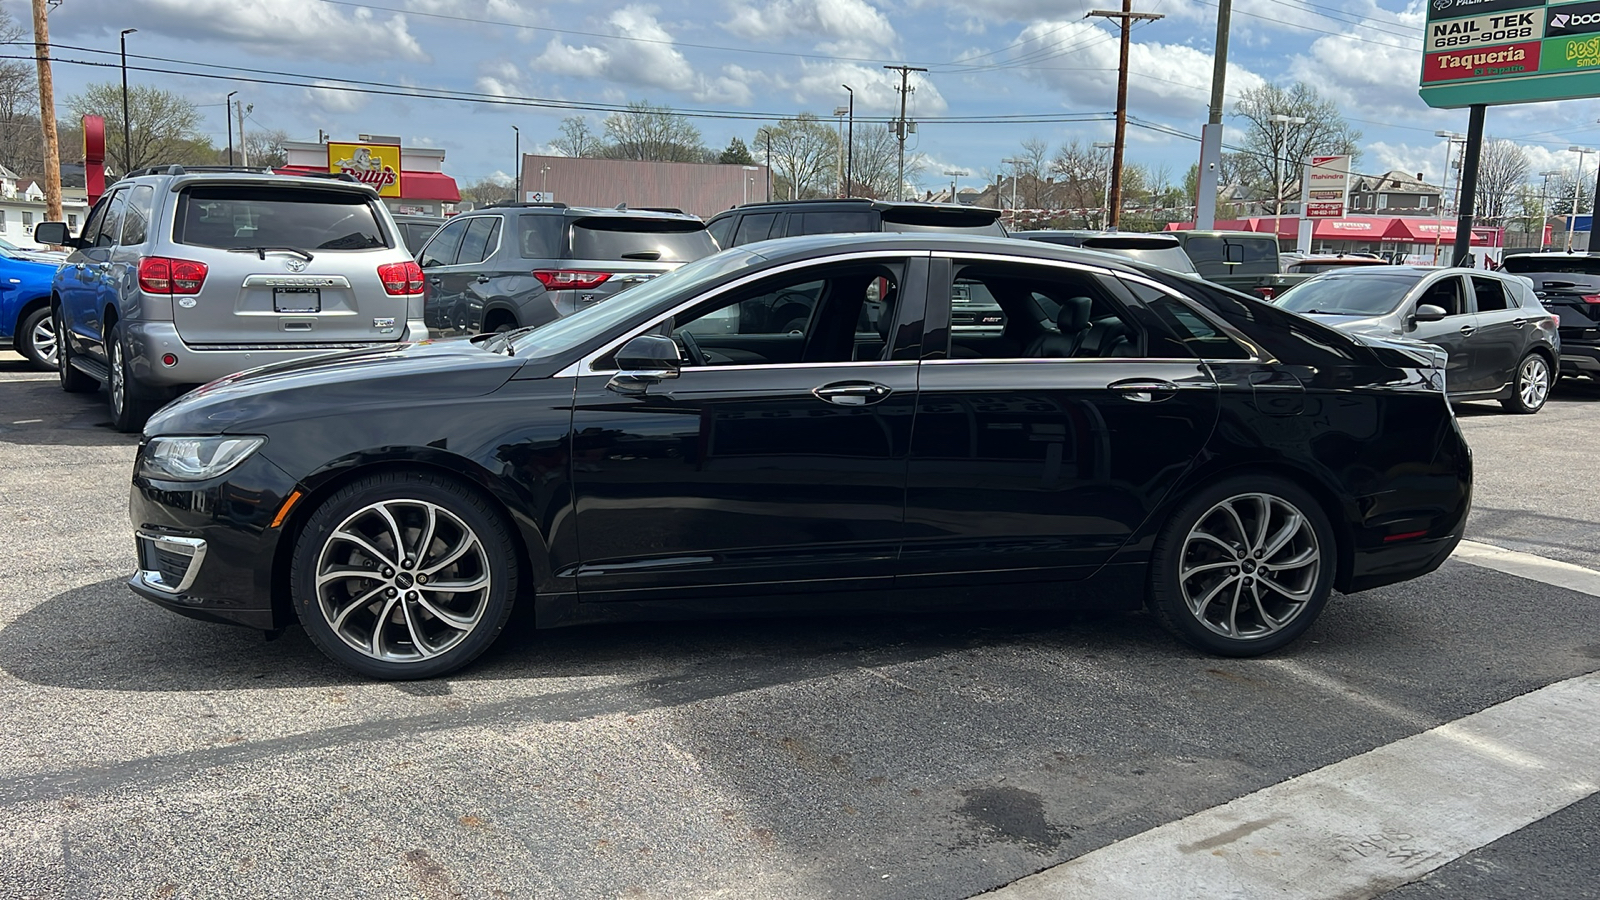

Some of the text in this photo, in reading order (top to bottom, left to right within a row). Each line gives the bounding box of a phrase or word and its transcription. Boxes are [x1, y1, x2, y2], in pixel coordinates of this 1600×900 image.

[1434, 12, 1535, 37] NAIL TEK
[1434, 27, 1532, 48] 689-9088
[1438, 46, 1525, 69] Taquería
[341, 166, 396, 192] Rally's
